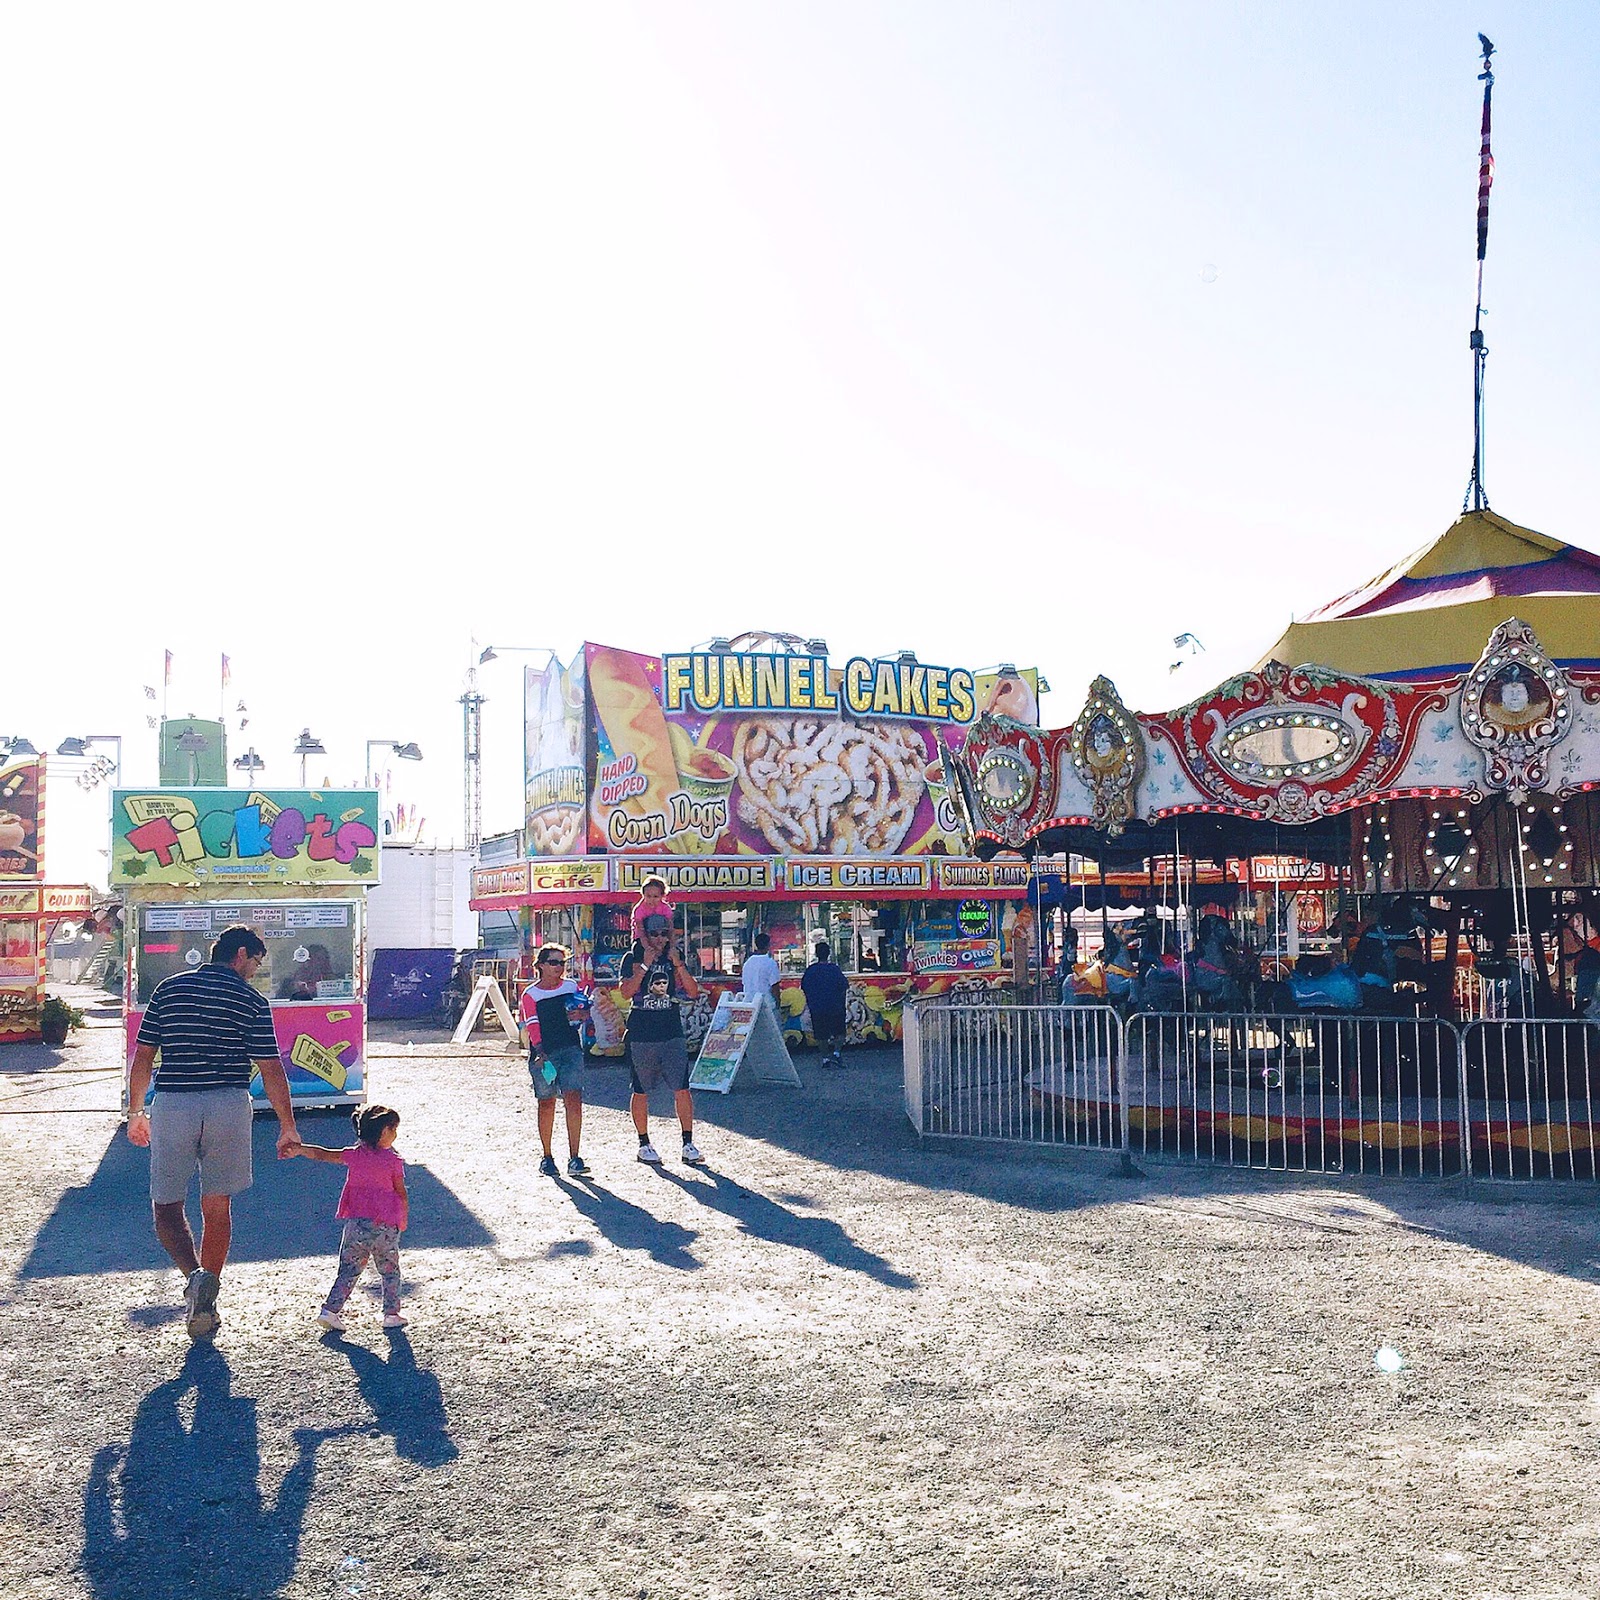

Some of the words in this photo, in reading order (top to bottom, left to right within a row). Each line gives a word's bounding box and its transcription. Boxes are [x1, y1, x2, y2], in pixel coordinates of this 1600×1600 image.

[666, 656, 838, 711] FUNNEL
[846, 658, 975, 722] CAKES
[602, 755, 634, 780] HAND
[602, 777, 645, 801] DIPPED
[609, 810, 666, 847] Corn
[670, 794, 727, 839] Dogs
[624, 865, 765, 887] LEMONADE
[793, 865, 832, 886] ICE
[840, 864, 920, 886] CREAM
[945, 865, 990, 886] SUNDAES
[993, 866, 1028, 886] FLOATS
[1256, 862, 1322, 878] DRINKS
[477, 873, 499, 896] CORN
[501, 871, 525, 892] DOGS
[537, 874, 595, 889] Café
[49, 894, 73, 906] COLD
[603, 934, 629, 949] CAKE
[914, 951, 957, 970] Twinkies
[962, 949, 994, 962] OREO
